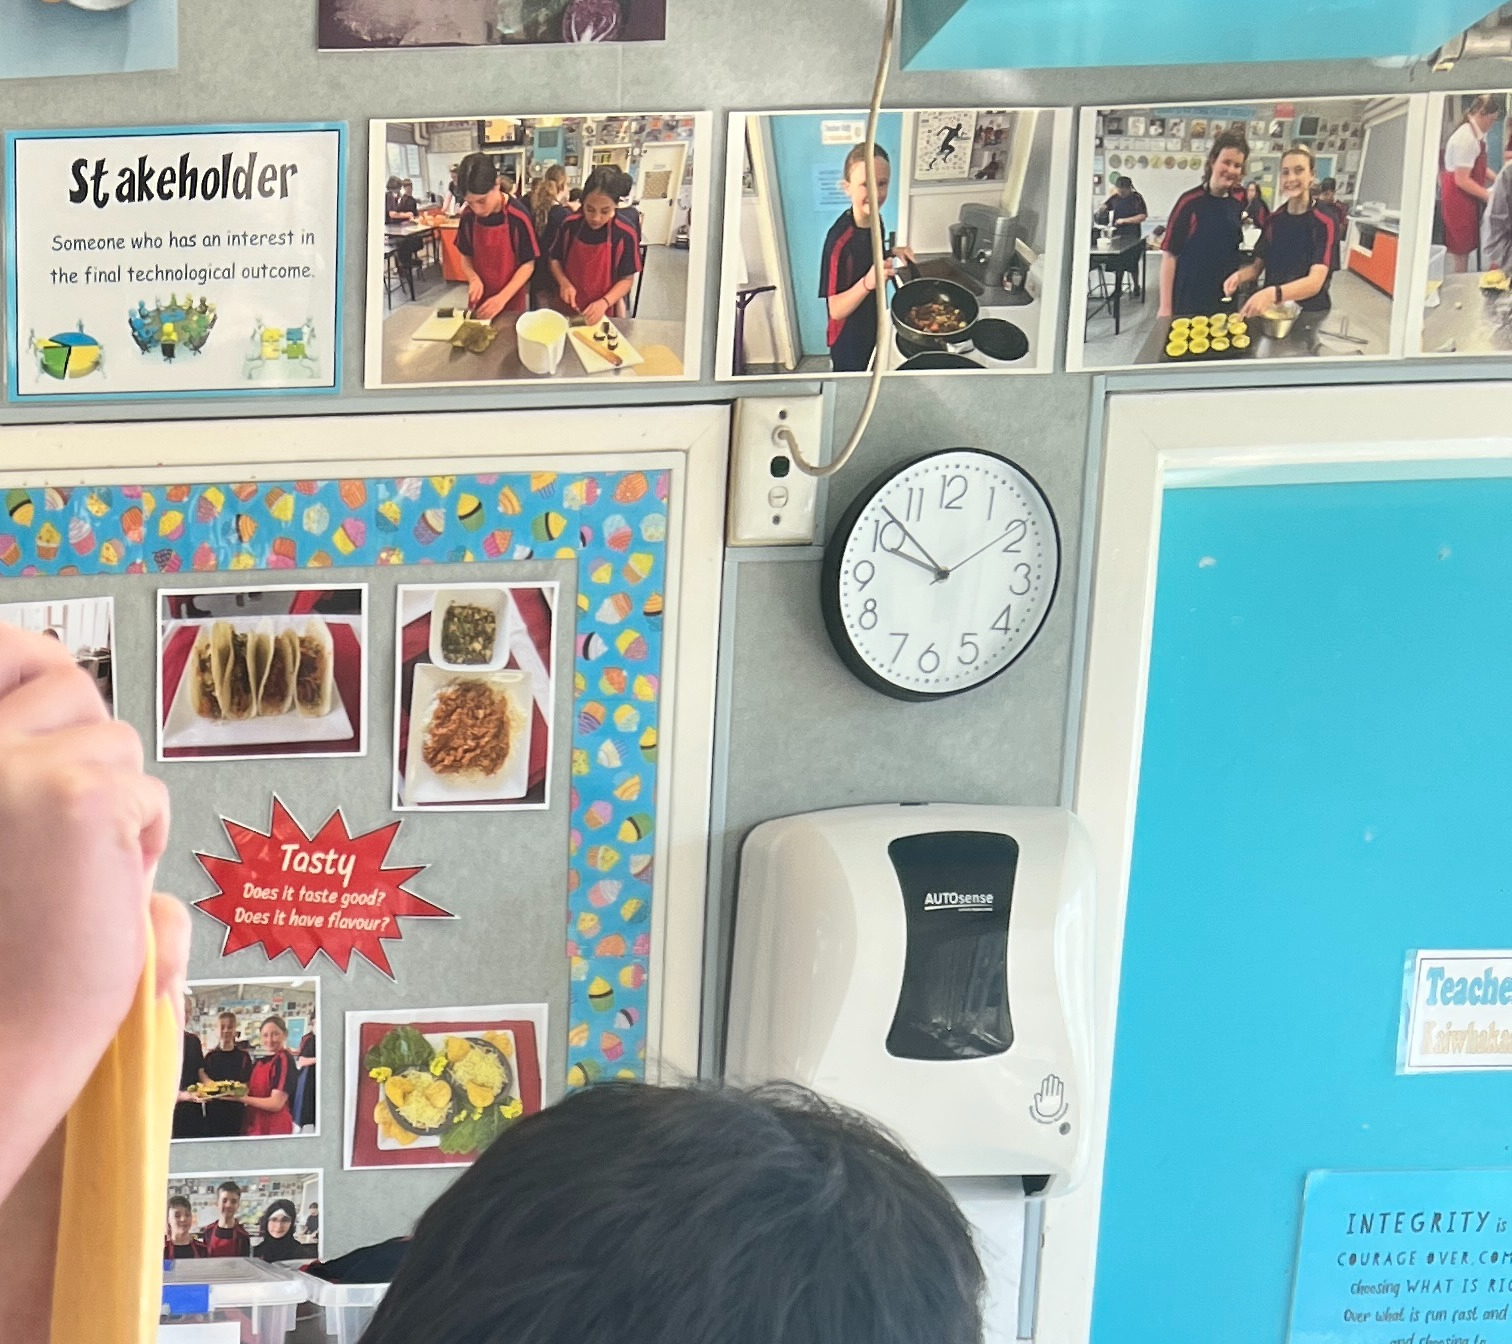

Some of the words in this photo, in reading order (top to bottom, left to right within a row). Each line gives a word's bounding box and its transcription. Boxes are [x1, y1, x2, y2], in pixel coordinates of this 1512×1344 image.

[68, 152, 298, 208] Stakeholder
[51, 235, 125, 251] Someone
[131, 234, 163, 249] who
[169, 232, 197, 248] has
[202, 234, 221, 247] an
[227, 230, 294, 247] interest
[302, 229, 315, 245] in
[49, 267, 78, 284] the
[85, 265, 121, 284] final
[127, 263, 235, 285] technological
[242, 265, 315, 280] outcome.
[906, 488, 924, 521] 11
[939, 474, 968, 509] 12
[988, 486, 995, 520] 1
[872, 519, 906, 553] 10
[1003, 519, 1027, 553] 2
[853, 560, 875, 592] 9
[1010, 563, 1031, 595] 3
[859, 598, 878, 630] 8
[990, 604, 1011, 635] 4
[890, 633, 909, 663] 7
[918, 643, 940, 673] 6
[958, 633, 979, 665] 5
[280, 843, 356, 888] Tasty
[243, 883, 279, 900] Does
[283, 885, 293, 901] it
[299, 886, 337, 903] taste
[341, 889, 386, 908] good?
[924, 892, 994, 906] AUTOsense
[234, 907, 269, 925] Does
[273, 909, 285, 926] it
[289, 909, 323, 927] have
[327, 911, 390, 932] flavour?
[1426, 966, 1512, 1006] Teache
[1346, 1211, 1490, 1234] INTEGRITY
[1496, 1218, 1508, 1233] is
[1337, 1252, 1416, 1266] COURAGE
[1426, 1252, 1468, 1266] OVER
[1350, 1280, 1400, 1297] choosing
[1406, 1280, 1454, 1293] WHAT
[1462, 1279, 1478, 1293] IS
